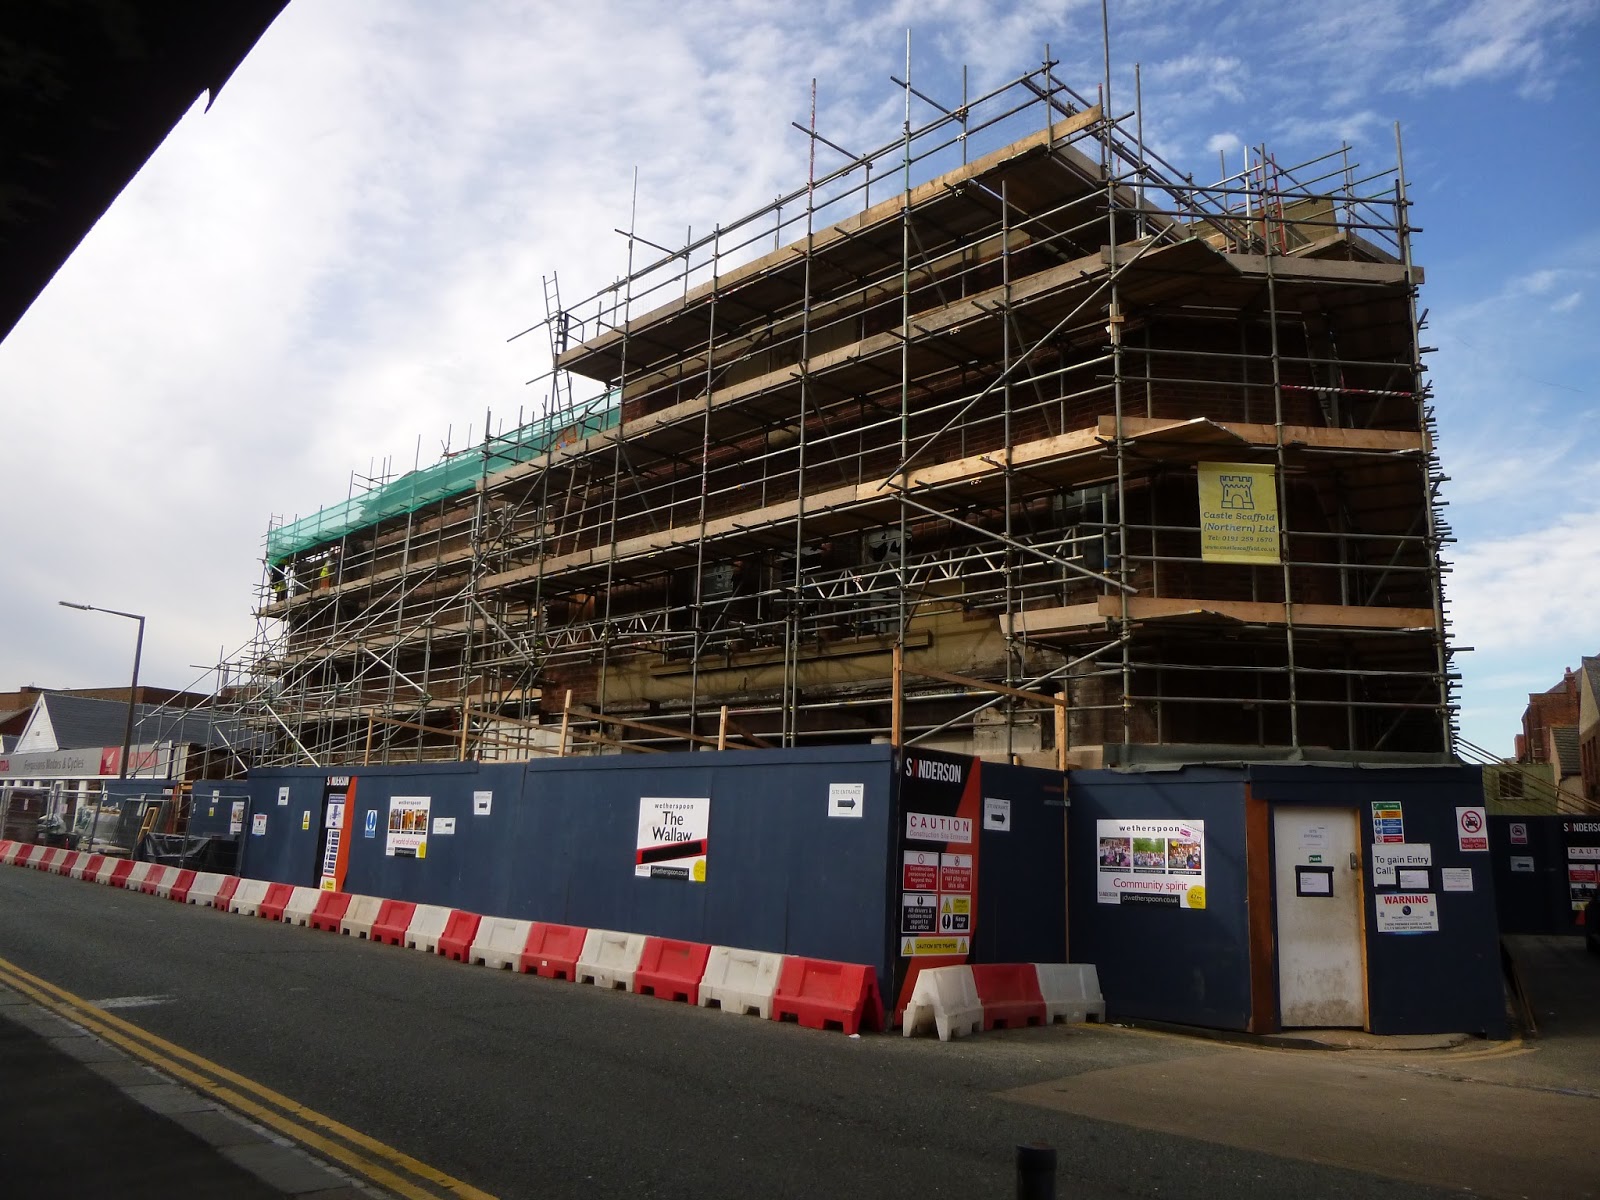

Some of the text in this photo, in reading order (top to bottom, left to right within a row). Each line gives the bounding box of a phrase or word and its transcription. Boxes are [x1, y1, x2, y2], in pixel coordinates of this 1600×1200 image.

[1203, 512, 1275, 522] Castle Scaffold
[1204, 522, 1276, 534] (Northern) Ltd
[67, 757, 84, 771] Cycles
[906, 757, 961, 783] SANDERSON
[663, 811, 684, 825] The
[910, 816, 969, 832] CAUTION
[652, 826, 692, 842] Wallaw
[910, 830, 939, 839] Construction
[1119, 825, 1180, 833] wetherspoon
[1387, 856, 1404, 865] gain
[1407, 856, 1429, 864] Entry
[1114, 878, 1188, 892] Community spirit
[1122, 895, 1178, 904] jdwetherspoon.co.uk
[1384, 895, 1429, 904] WARNING
